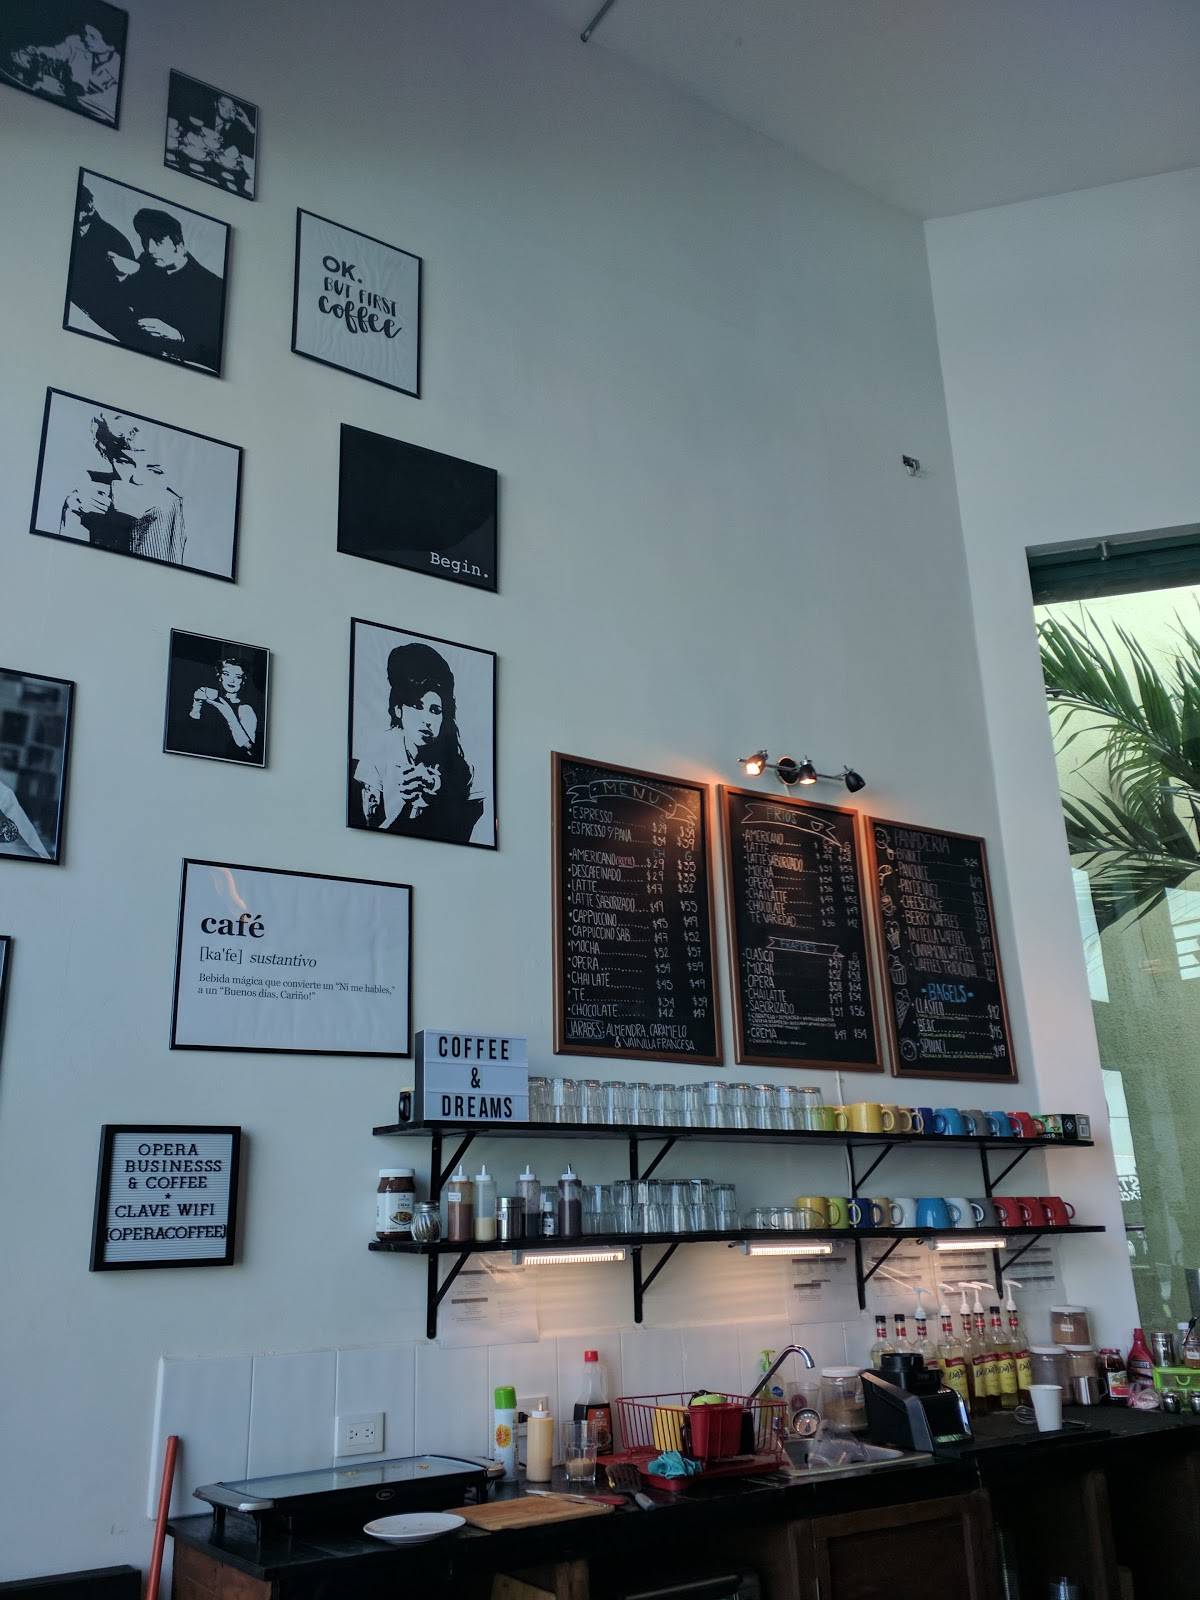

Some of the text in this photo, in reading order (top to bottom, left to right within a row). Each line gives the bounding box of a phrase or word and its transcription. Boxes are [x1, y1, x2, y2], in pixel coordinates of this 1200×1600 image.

[322, 255, 363, 284] OK.
[323, 277, 397, 317] BUT FIRST
[429, 551, 489, 579] Begin.
[603, 782, 661, 804] MENU
[571, 806, 613, 824] ESPRESSO
[570, 821, 606, 838] ESPRESSO
[746, 842, 770, 854] LATTE
[571, 864, 622, 882] DESCAFEINADO
[571, 880, 598, 893] LATTE
[571, 892, 595, 911] LATTE
[680, 899, 698, 913] $55
[200, 913, 265, 939] café
[571, 909, 618, 928] CAPPUCCINO
[571, 925, 616, 941] CAPPUCCINO
[571, 940, 601, 956] MOCHA
[249, 953, 317, 969] sustantivo
[571, 956, 600, 970] OPERA
[746, 961, 775, 977] MOCHA
[199, 972, 231, 984] Bebida
[232, 975, 264, 987] mágica
[264, 979, 282, 989] que
[282, 979, 322, 990] convierte
[322, 983, 335, 991] un
[350, 984, 365, 993] me
[747, 975, 775, 989] OPERA
[197, 986, 204, 995] a
[205, 987, 219, 995] un
[572, 988, 586, 1001] TE
[571, 1004, 620, 1018] CHOCOLATE
[749, 1000, 795, 1015] SABORIZADO
[750, 1028, 778, 1039] CREMA
[438, 1035, 510, 1061] COFFEE
[470, 1066, 482, 1089] &
[441, 1094, 514, 1119] DREAMS
[137, 1142, 199, 1156] OPERA
[124, 1159, 223, 1173] BUSINESSS
[127, 1175, 209, 1190] & COFFEE
[113, 1202, 215, 1218] CLAVE WIFI
